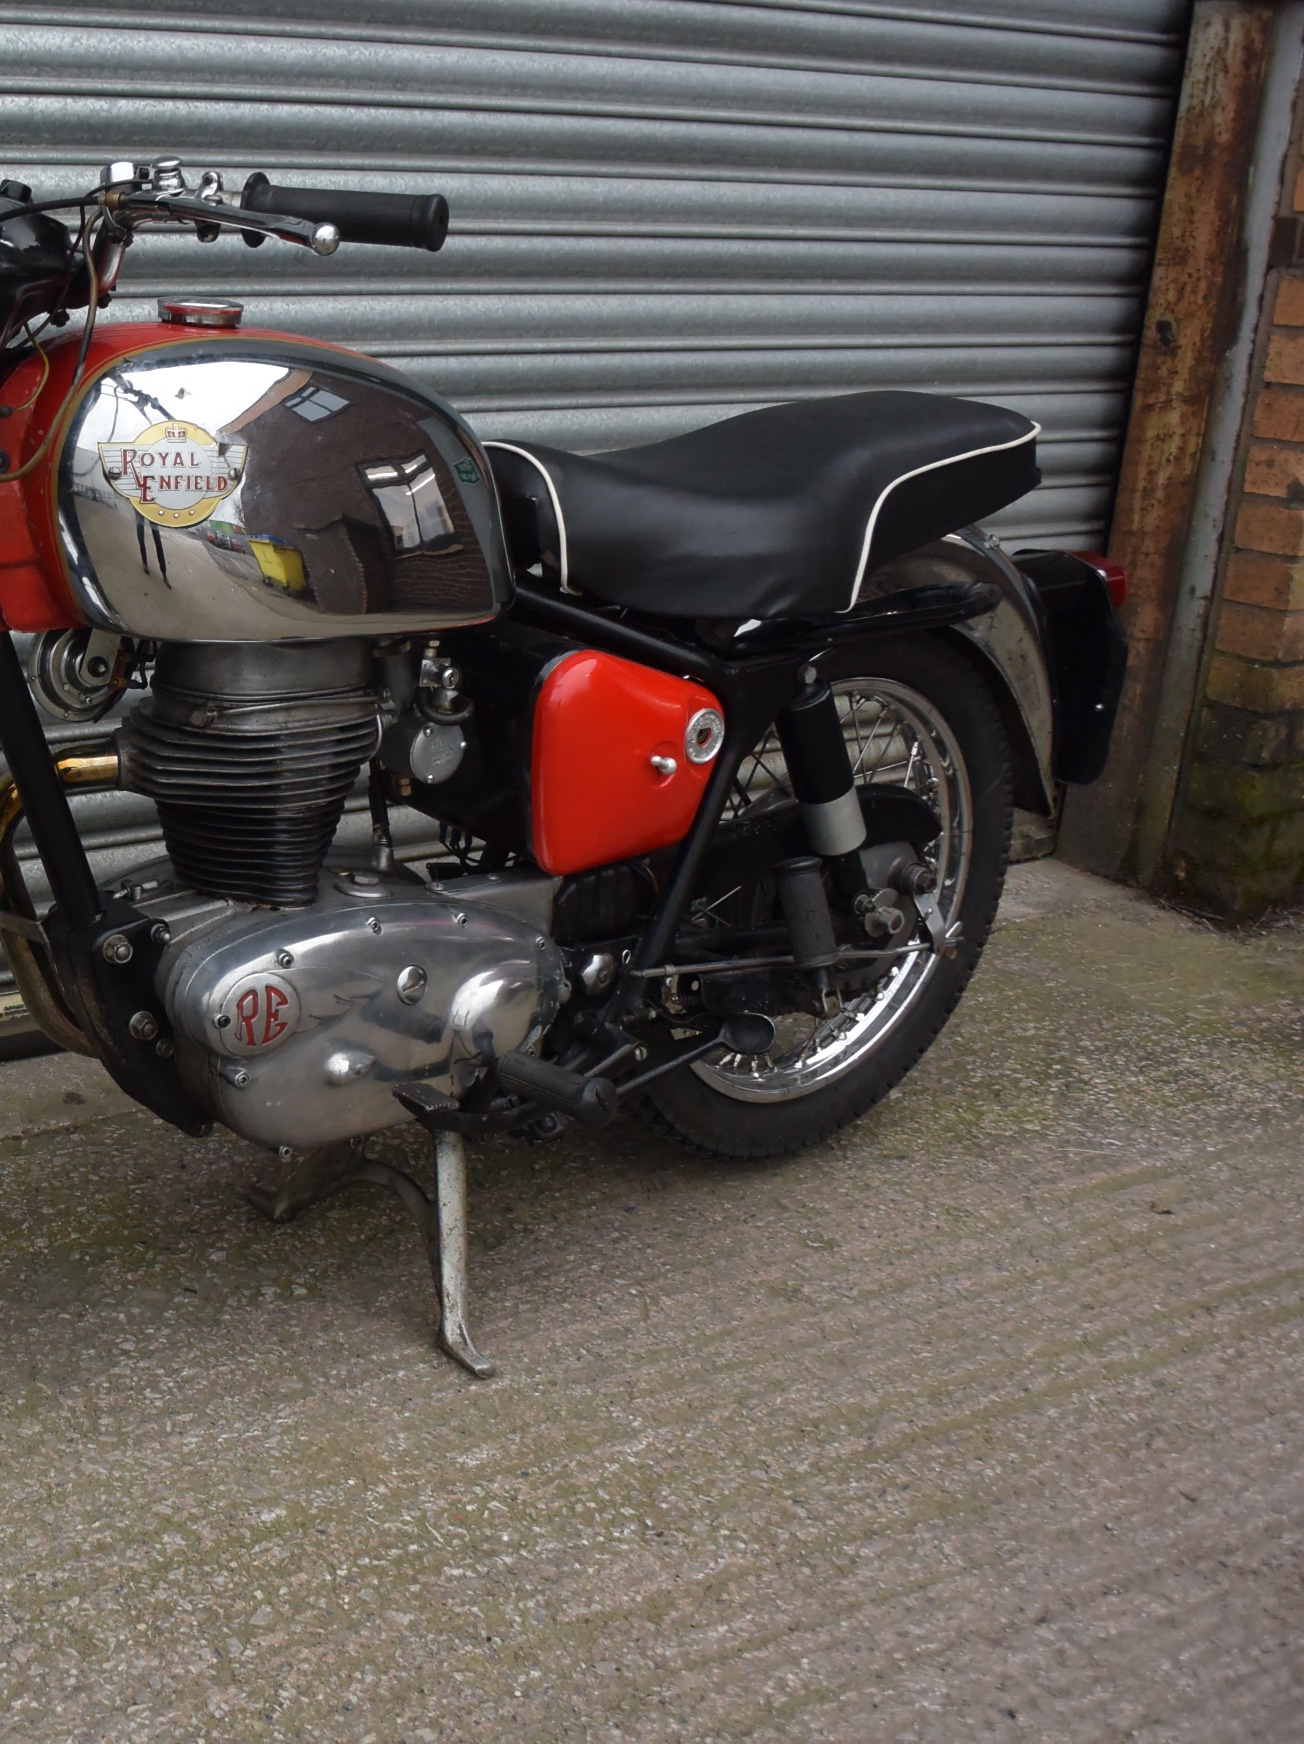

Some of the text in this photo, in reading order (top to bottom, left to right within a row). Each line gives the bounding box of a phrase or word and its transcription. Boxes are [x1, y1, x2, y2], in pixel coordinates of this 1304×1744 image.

[121, 448, 201, 489] ROYAL
[140, 475, 229, 504] ENFIELD
[234, 985, 290, 1047] RE
